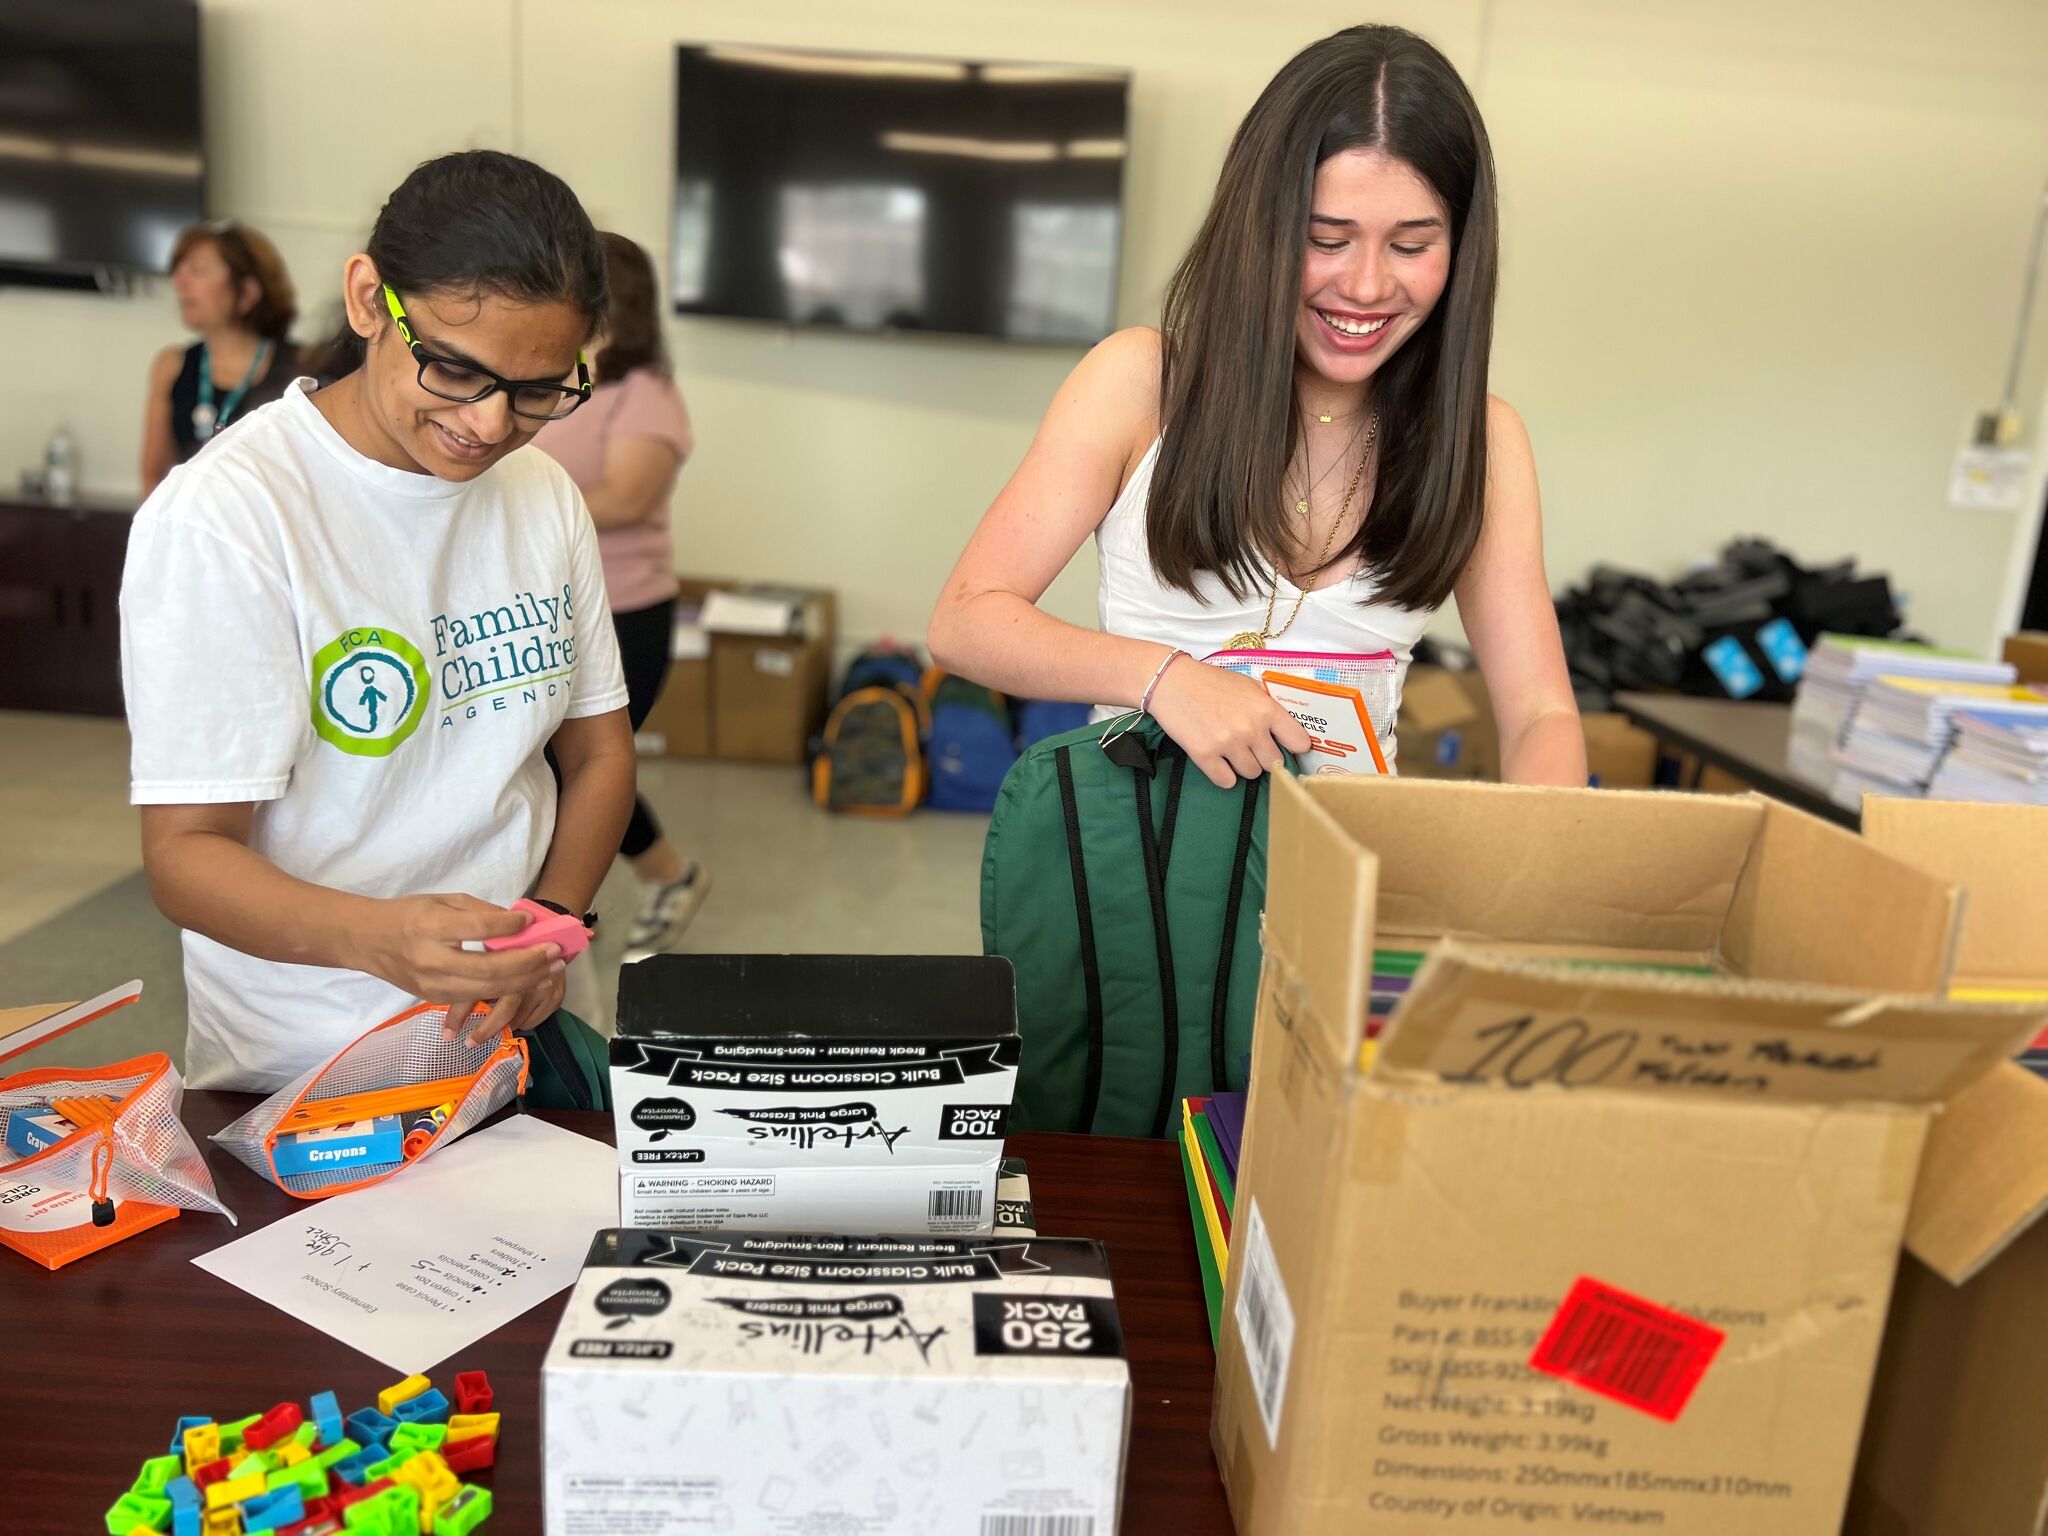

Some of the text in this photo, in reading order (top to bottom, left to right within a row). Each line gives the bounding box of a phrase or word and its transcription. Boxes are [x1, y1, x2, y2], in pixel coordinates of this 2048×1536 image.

[430, 584, 573, 656] Family &
[339, 630, 383, 653] FCA
[1288, 711, 1327, 725] OLORED
[1300, 722, 1325, 733] CILS
[714, 1045, 816, 1057] Non-Smudging
[828, 1046, 886, 1056] Resistant
[890, 1046, 925, 1057] Break
[1439, 1015, 1640, 1090] 100
[691, 1068, 941, 1085] Bulk Classroom Size Pack
[749, 1106, 868, 1121] Large Pink Erasers
[953, 1108, 1001, 1120] PACK
[950, 1121, 995, 1136] 100
[27, 1131, 50, 1152] Cray
[309, 1146, 366, 1162] Crayons
[636, 1153, 661, 1161] FREE
[0, 1185, 28, 1198] CILS
[2, 1187, 40, 1204] ORED
[50, 1193, 86, 1209] uttle
[997, 1204, 1024, 1213] PAC
[999, 1212, 1025, 1224] 10
[492, 1235, 535, 1256] sharpener
[744, 1240, 843, 1253] Non-Smudging
[857, 1242, 914, 1254] Resistant
[918, 1243, 956, 1255] Break
[438, 1254, 470, 1270] pencils
[490, 1248, 518, 1264] folders
[471, 1268, 490, 1280] color
[713, 1259, 976, 1279] Bulk Classroom Size Pack
[396, 1282, 417, 1294] case
[416, 1275, 431, 1285] box
[302, 1274, 378, 1314] Elementary School
[430, 1281, 459, 1298] crayon
[610, 1289, 660, 1297] Favorite
[418, 1291, 442, 1308] Pencil
[601, 1295, 666, 1305] Classroom
[744, 1300, 894, 1314] Large Pink Erasers
[1004, 1302, 1086, 1320] PACK
[1399, 1290, 1466, 1315] Buyer
[1665, 1299, 1767, 1327] lutions
[1001, 1319, 1092, 1350] 250
[1393, 1325, 1439, 1345] Part
[573, 1342, 614, 1356] FREE
[1382, 1392, 1427, 1412] Net
[1430, 1394, 1508, 1418] Weight:
[1379, 1425, 1610, 1458] Gross Weight: 3.99kg
[1374, 1458, 1792, 1498] Dimensions: 250mmx185mmx310mm
[1369, 1492, 1664, 1526] Country of Origin: Vietnam
